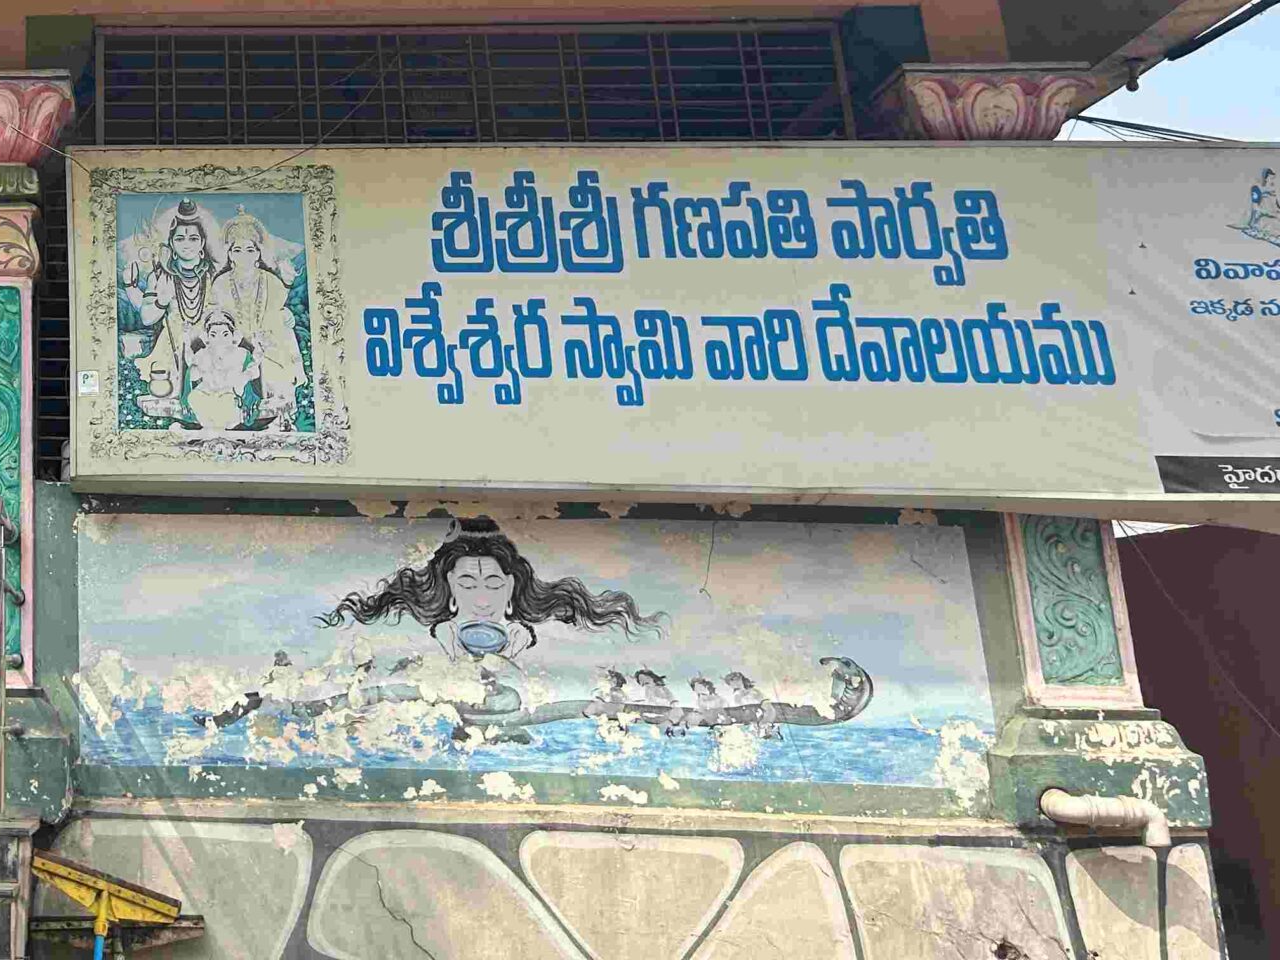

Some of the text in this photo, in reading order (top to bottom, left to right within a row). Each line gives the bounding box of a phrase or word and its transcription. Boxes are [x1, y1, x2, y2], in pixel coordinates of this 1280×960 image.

[431, 171, 1009, 286] శ్రీశ్రీశ్రీ గణపతి పార్వతి
[362, 281, 1117, 408] విశ్వేశ్వర స్వామి వారి దేవాలయము
[1189, 297, 1254, 322] ఇక్కడ
[1218, 464, 1280, 490] హైద
